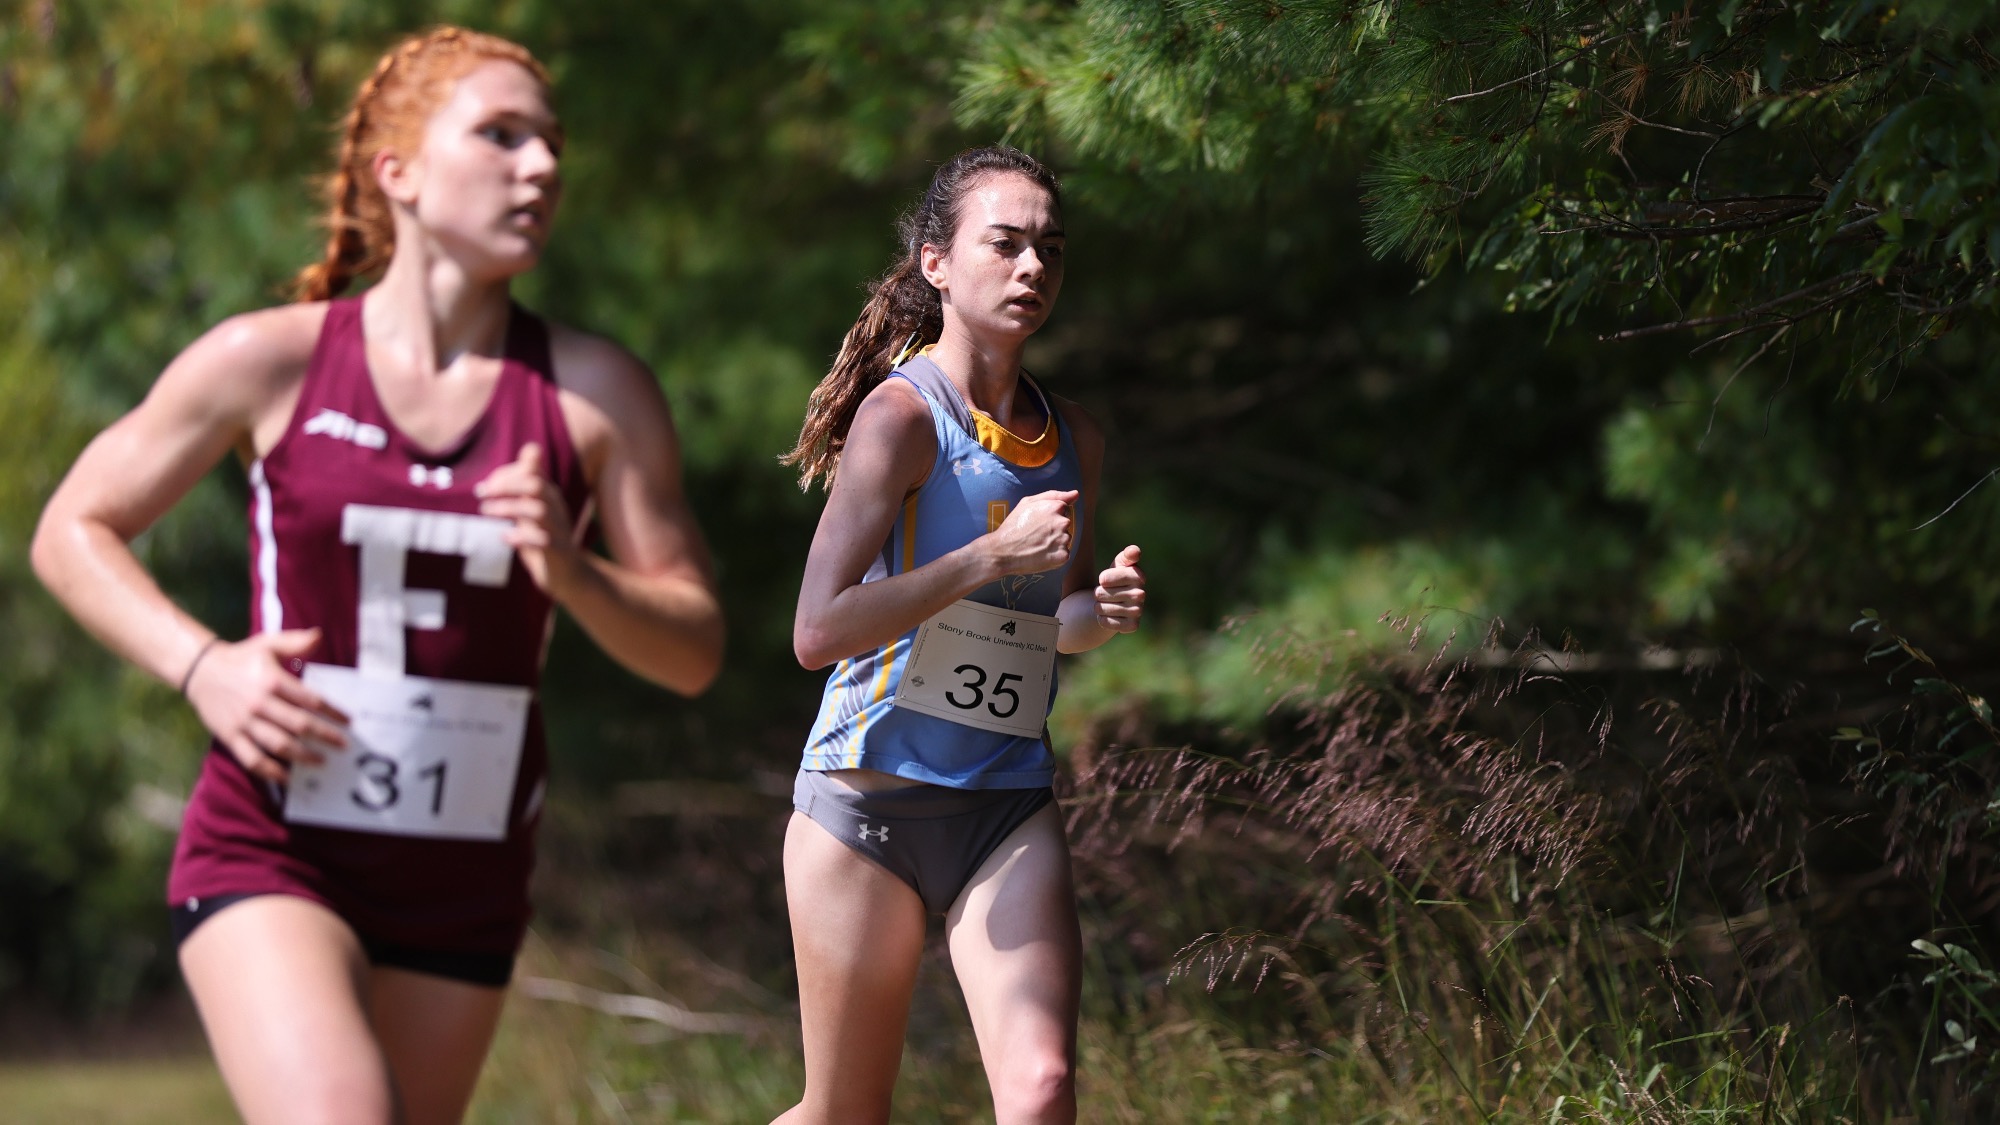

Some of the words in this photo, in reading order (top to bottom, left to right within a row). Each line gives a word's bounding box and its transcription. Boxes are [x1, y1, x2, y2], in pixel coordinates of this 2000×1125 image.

[341, 503, 515, 676] F
[937, 622, 964, 635] Stony
[965, 630, 992, 643] Brook
[993, 637, 1025, 650] University
[1025, 643, 1035, 651] XC
[945, 664, 1023, 718] 35
[351, 752, 447, 817] 31
